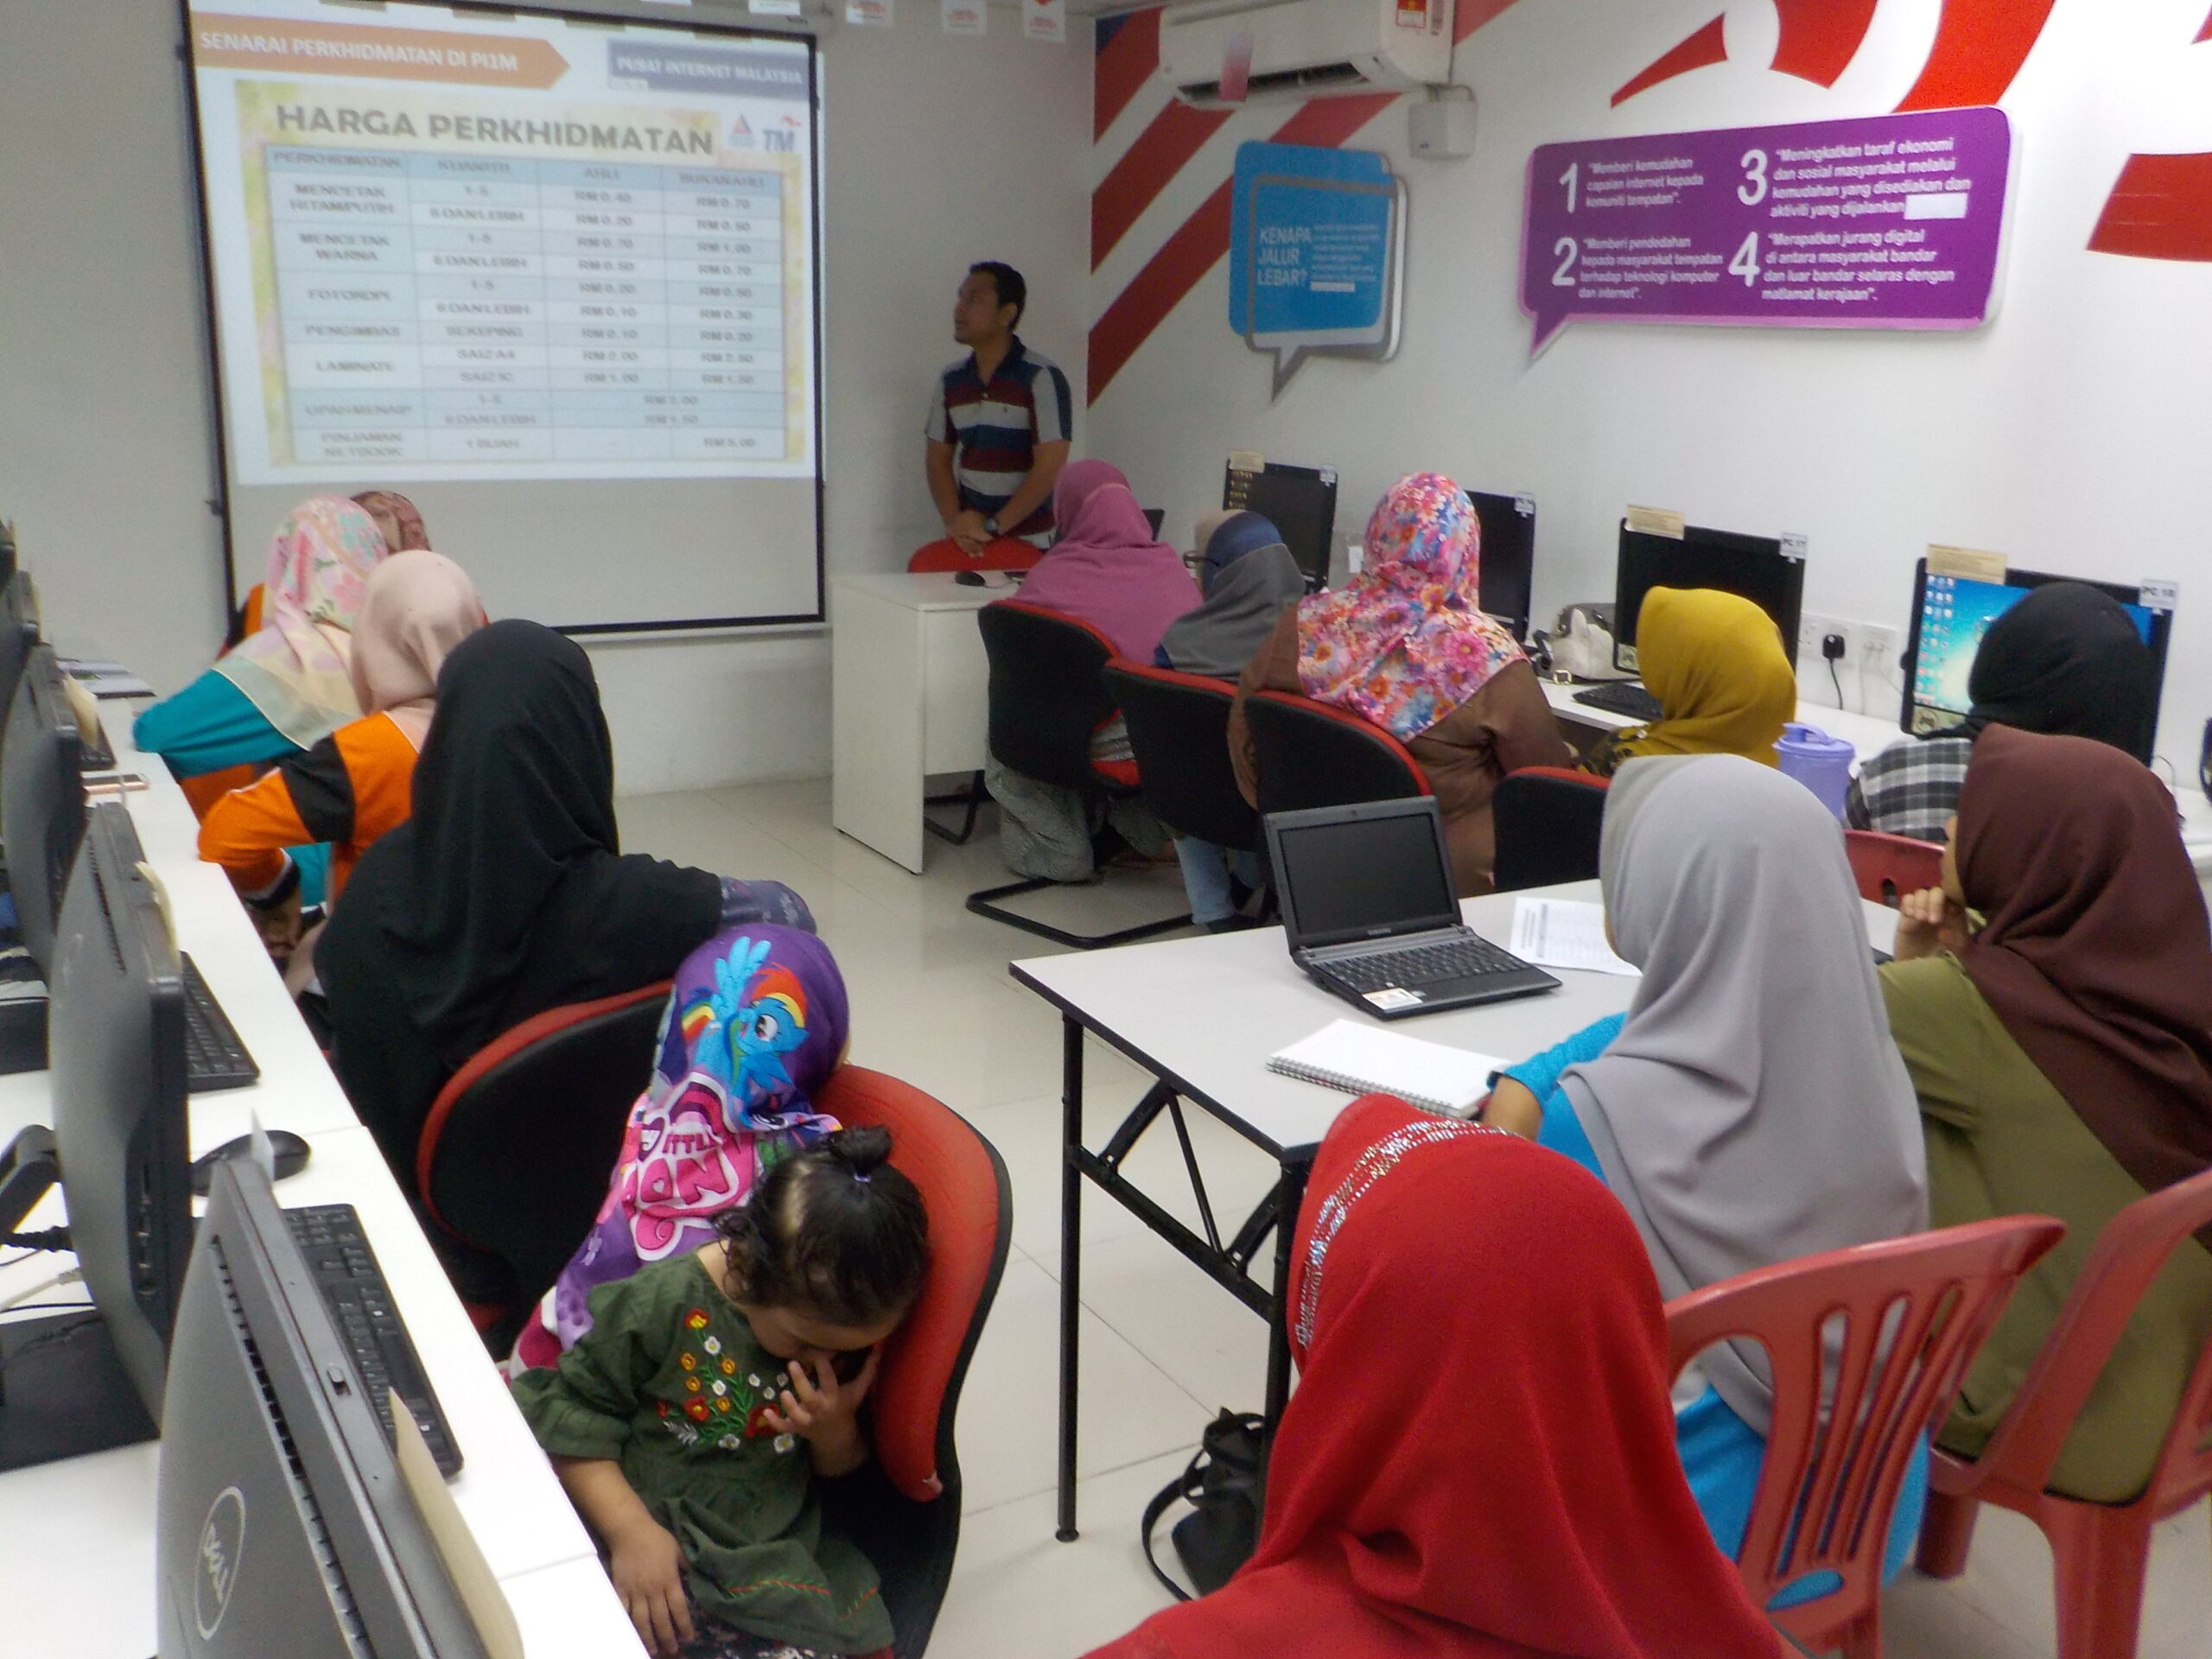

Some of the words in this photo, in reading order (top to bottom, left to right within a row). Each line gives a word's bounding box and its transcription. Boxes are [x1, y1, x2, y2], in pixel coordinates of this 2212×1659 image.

[200, 33, 287, 54] SENARAI
[293, 39, 442, 66] PERKHIDMATAN
[447, 52, 467, 68] DI
[617, 57, 663, 73] PUSAT
[666, 60, 732, 79] INTERNET
[736, 66, 804, 85] MALAYSIA
[277, 104, 417, 137] HARGA
[429, 113, 714, 155] PERKHIDMATAN
[763, 129, 795, 152] TM
[1897, 137, 1955, 155] ekonomi
[1736, 148, 1769, 207] 3
[1773, 168, 1796, 181] dan
[1797, 164, 1833, 180] sosial
[1834, 160, 1906, 180] masyarakat
[1559, 162, 1579, 214] 1
[1772, 183, 1840, 200] kemudahan
[1840, 184, 1872, 200] yang
[1872, 178, 1943, 195] disediakan
[1944, 176, 1972, 192] dan
[1810, 204, 1840, 219] yang
[1260, 226, 1312, 245] KENAPA
[1841, 231, 1883, 248] jurang
[1884, 227, 1926, 247] digital
[1258, 246, 1300, 264] JALUR
[1552, 236, 1579, 287] 2
[1727, 231, 1761, 287] 4
[1778, 251, 1816, 264] antara
[1817, 249, 1889, 266] masyarakat
[1890, 247, 1938, 263] bandar
[1256, 268, 1308, 287] LEBAR?
[1763, 269, 1786, 283] dan
[1787, 269, 1812, 283] luar
[1812, 268, 1856, 283] bandar
[1856, 268, 1904, 283] selaras
[1904, 269, 1956, 285] dengan
